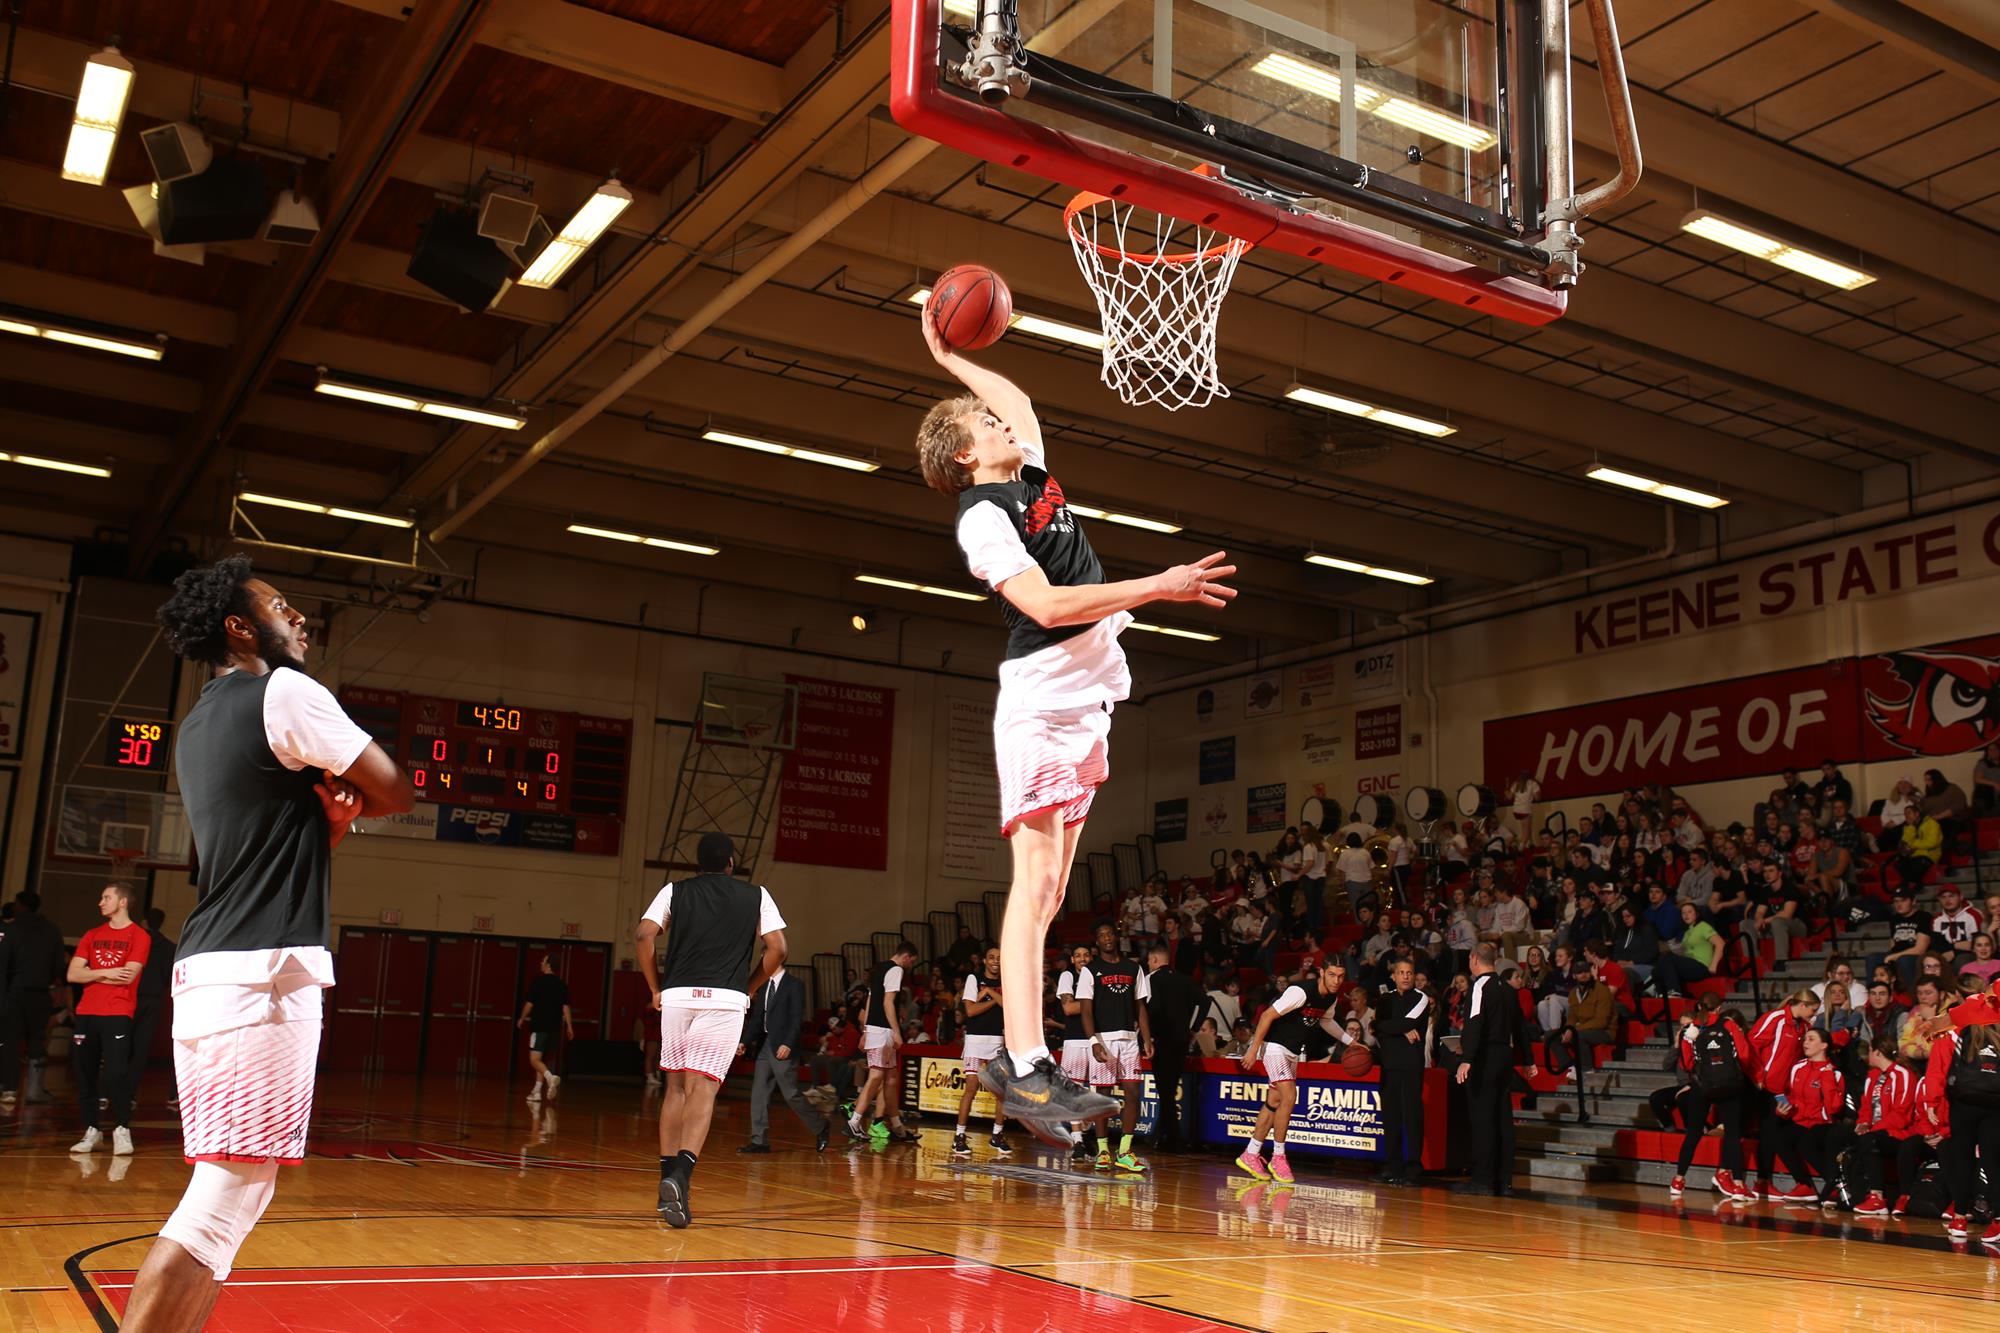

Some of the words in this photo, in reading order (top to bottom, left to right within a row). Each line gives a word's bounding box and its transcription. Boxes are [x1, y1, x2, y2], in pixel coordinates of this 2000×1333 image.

[1574, 574, 1740, 654] KEENE
[1758, 525, 1958, 616] STATE
[1368, 653, 1394, 672] DTZ
[840, 687, 884, 704] LACROSSE
[474, 706, 521, 732] 4:50
[124, 723, 161, 741] 4:50
[416, 724, 446, 736] OWLS
[1535, 707, 1721, 784] HOME
[1737, 689, 1828, 754] OF
[118, 737, 152, 766] 30
[432, 740, 447, 761] 0
[528, 737, 560, 750] GUEST
[487, 748, 493, 764] 1
[546, 752, 559, 773] 0
[414, 770, 425, 787] 0
[440, 773, 451, 789] 4
[798, 765, 825, 780] MEN'S
[828, 768, 872, 785] LACROSSE
[1357, 773, 1400, 793] GNC
[517, 781, 528, 796] 4
[545, 783, 556, 800] 0
[392, 812, 436, 828] Cellular
[450, 808, 510, 828] PEPSI
[692, 989, 712, 999] OWLS
[925, 1061, 967, 1090] GemGr
[1219, 1081, 1299, 1105] FENT
[1307, 1086, 1382, 1112] FAMILY
[1217, 1113, 1241, 1122] TOYOTA
[1315, 1122, 1347, 1132] HYUNDAI
[1353, 1125, 1385, 1135] SUBAR
[1306, 1103, 1376, 1127] Dealerships
